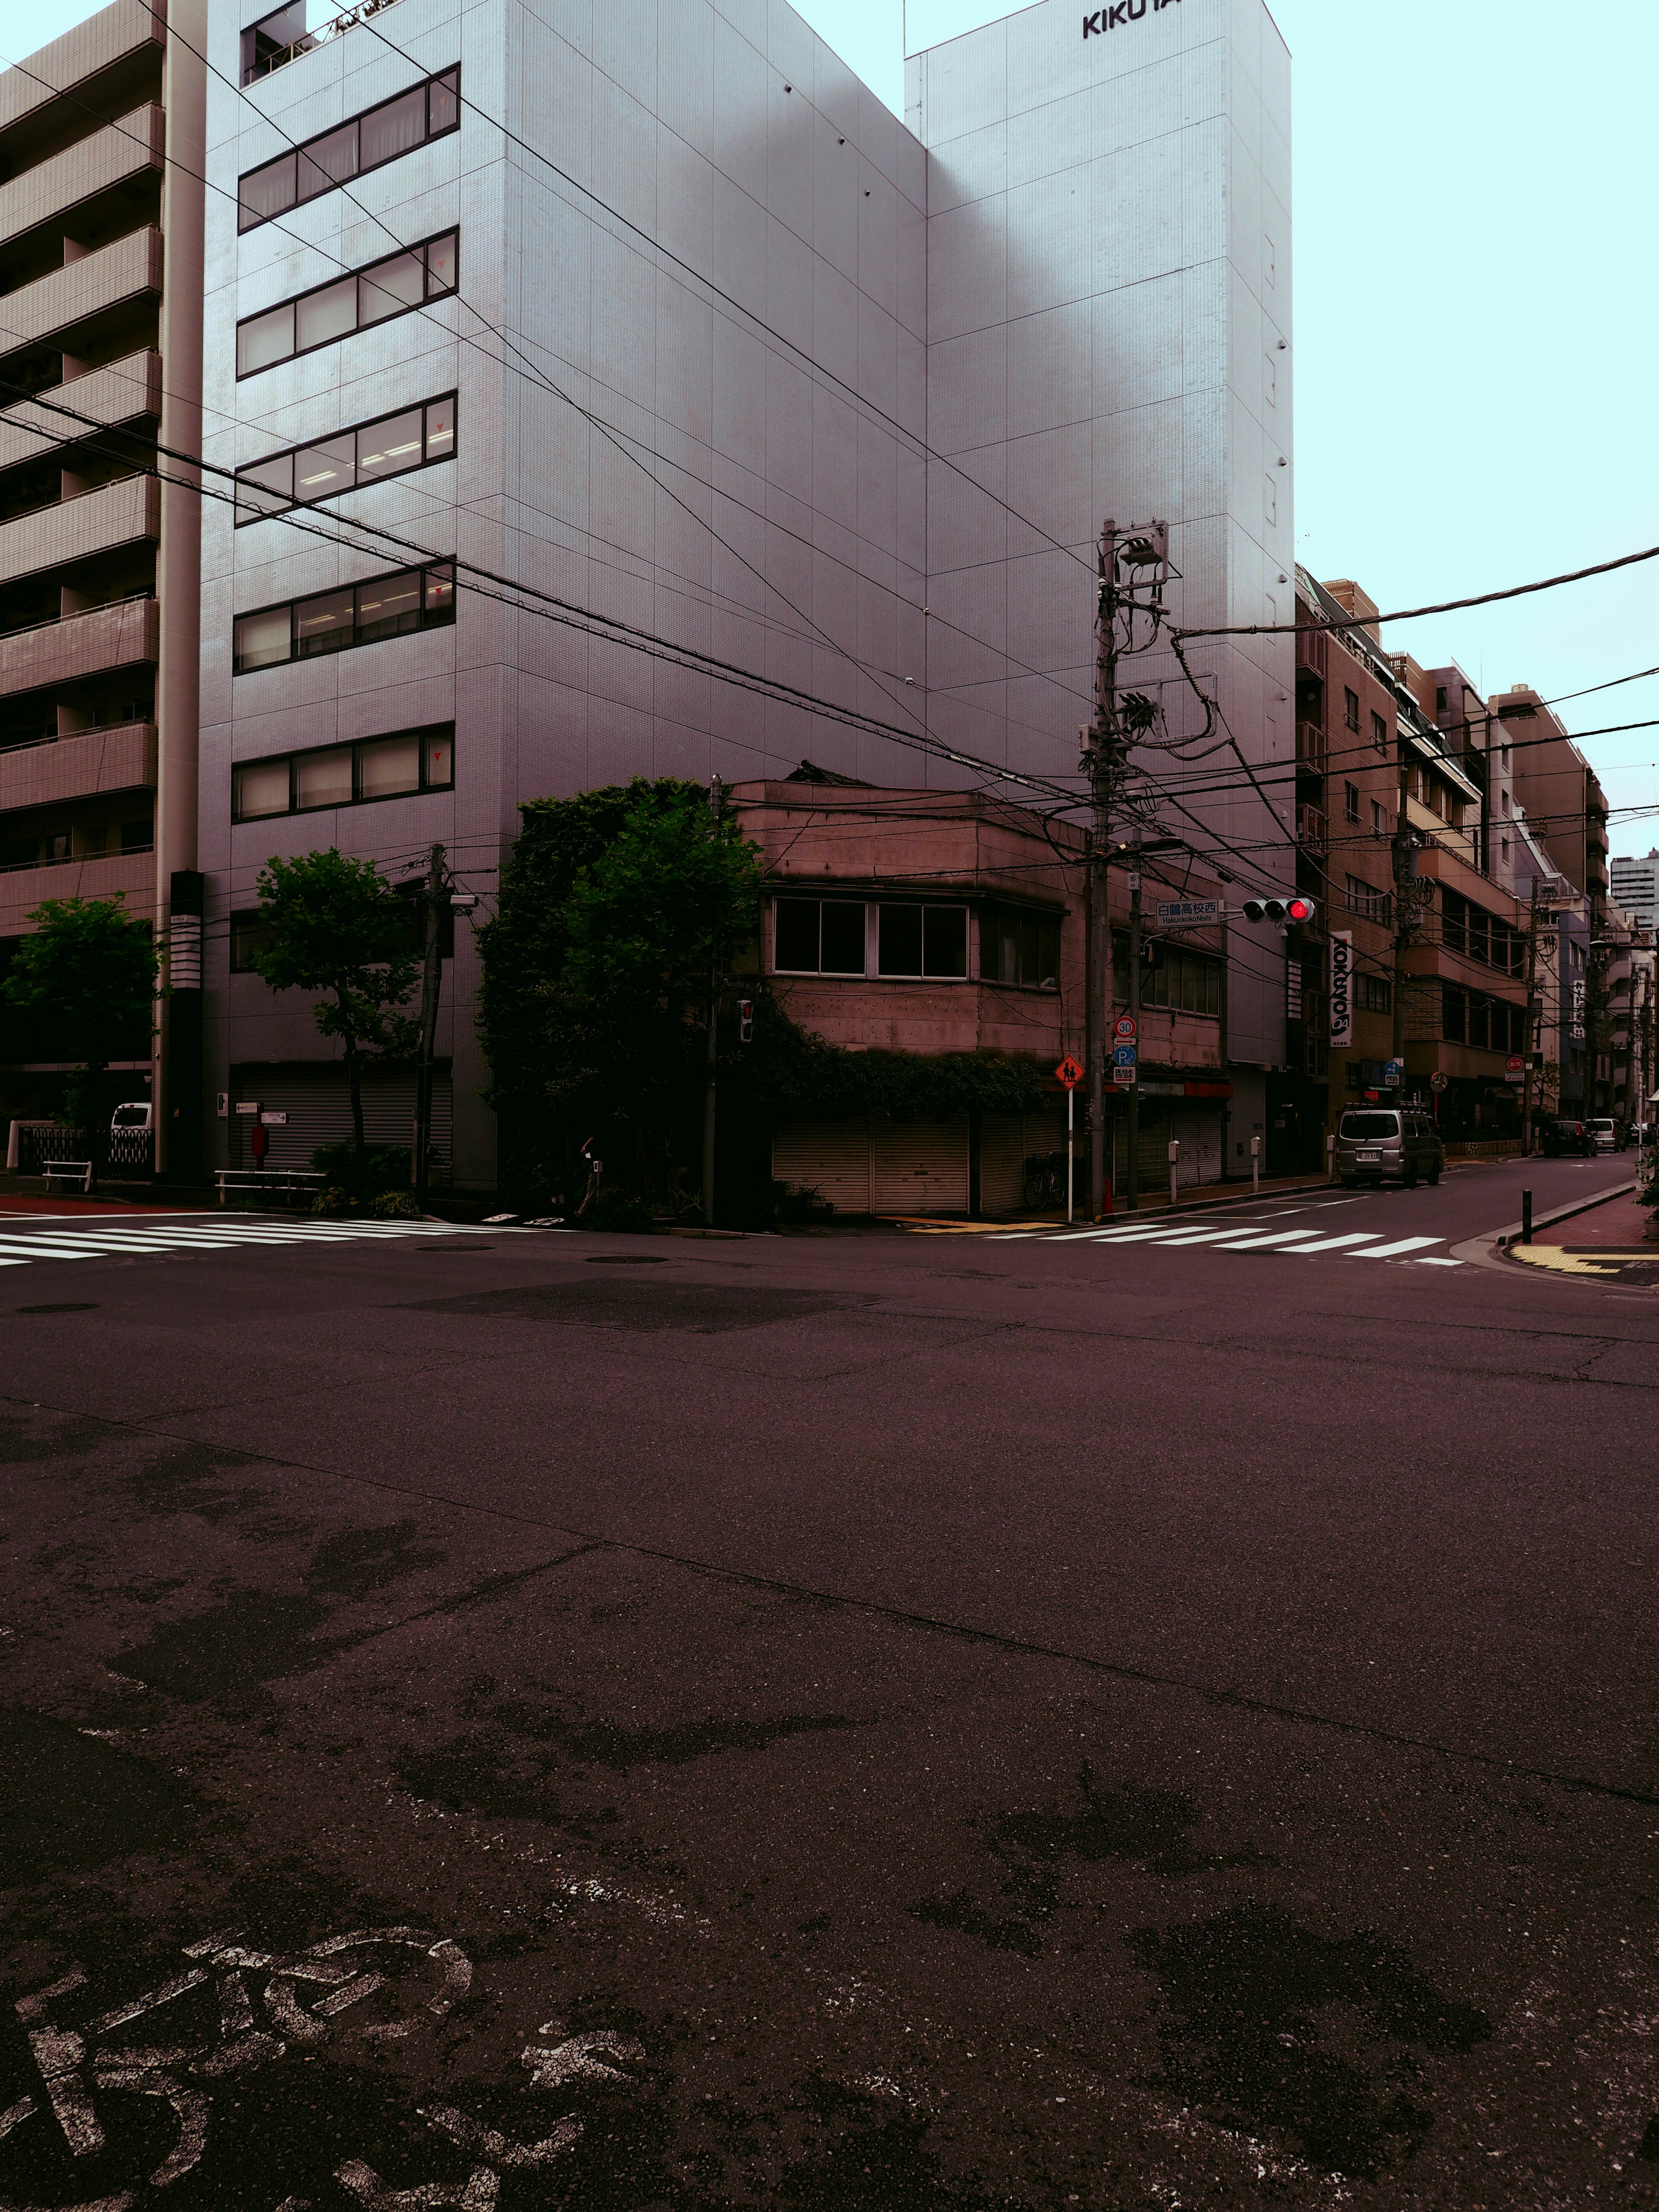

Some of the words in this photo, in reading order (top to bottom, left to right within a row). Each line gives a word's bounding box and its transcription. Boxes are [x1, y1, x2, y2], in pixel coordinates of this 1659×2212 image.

[1333, 939, 1348, 1014] KOKUYO
[1119, 1023, 1131, 1032] 30
[1119, 1051, 1127, 1064] P
